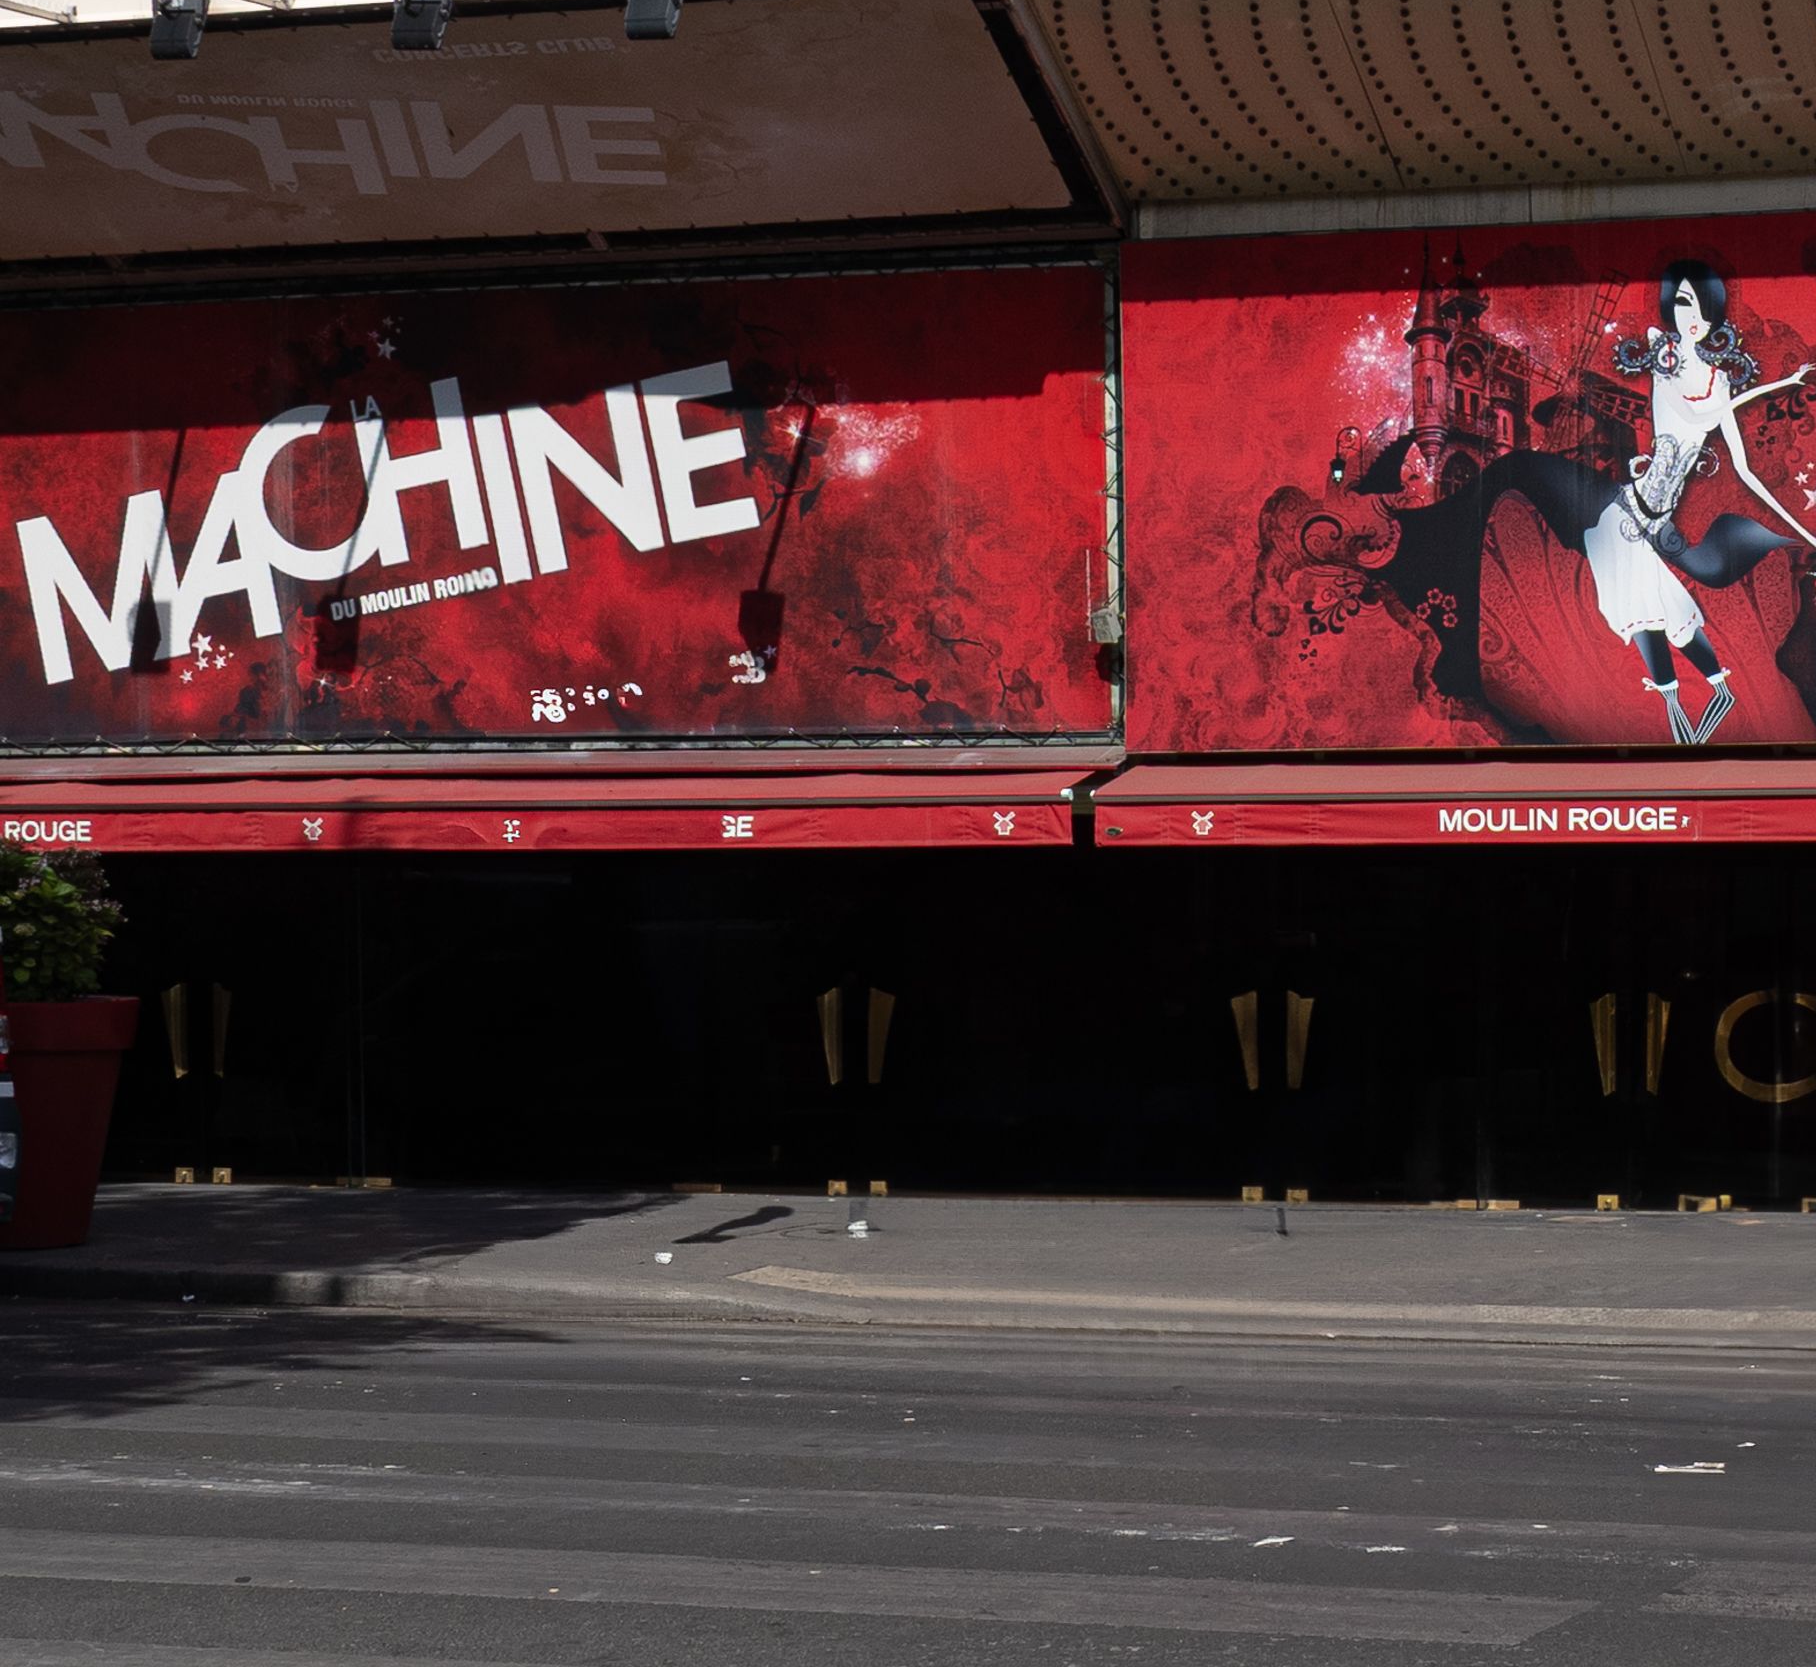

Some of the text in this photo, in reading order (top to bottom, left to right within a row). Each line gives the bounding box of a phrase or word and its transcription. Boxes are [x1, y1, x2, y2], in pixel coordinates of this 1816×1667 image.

[350, 395, 382, 422] LA
[16, 360, 760, 685] MACHINE
[330, 598, 357, 621] DU
[359, 581, 431, 615] MOULIN
[4, 820, 92, 842] ROUGE
[1438, 806, 1678, 832] MOULIN ROUGE
